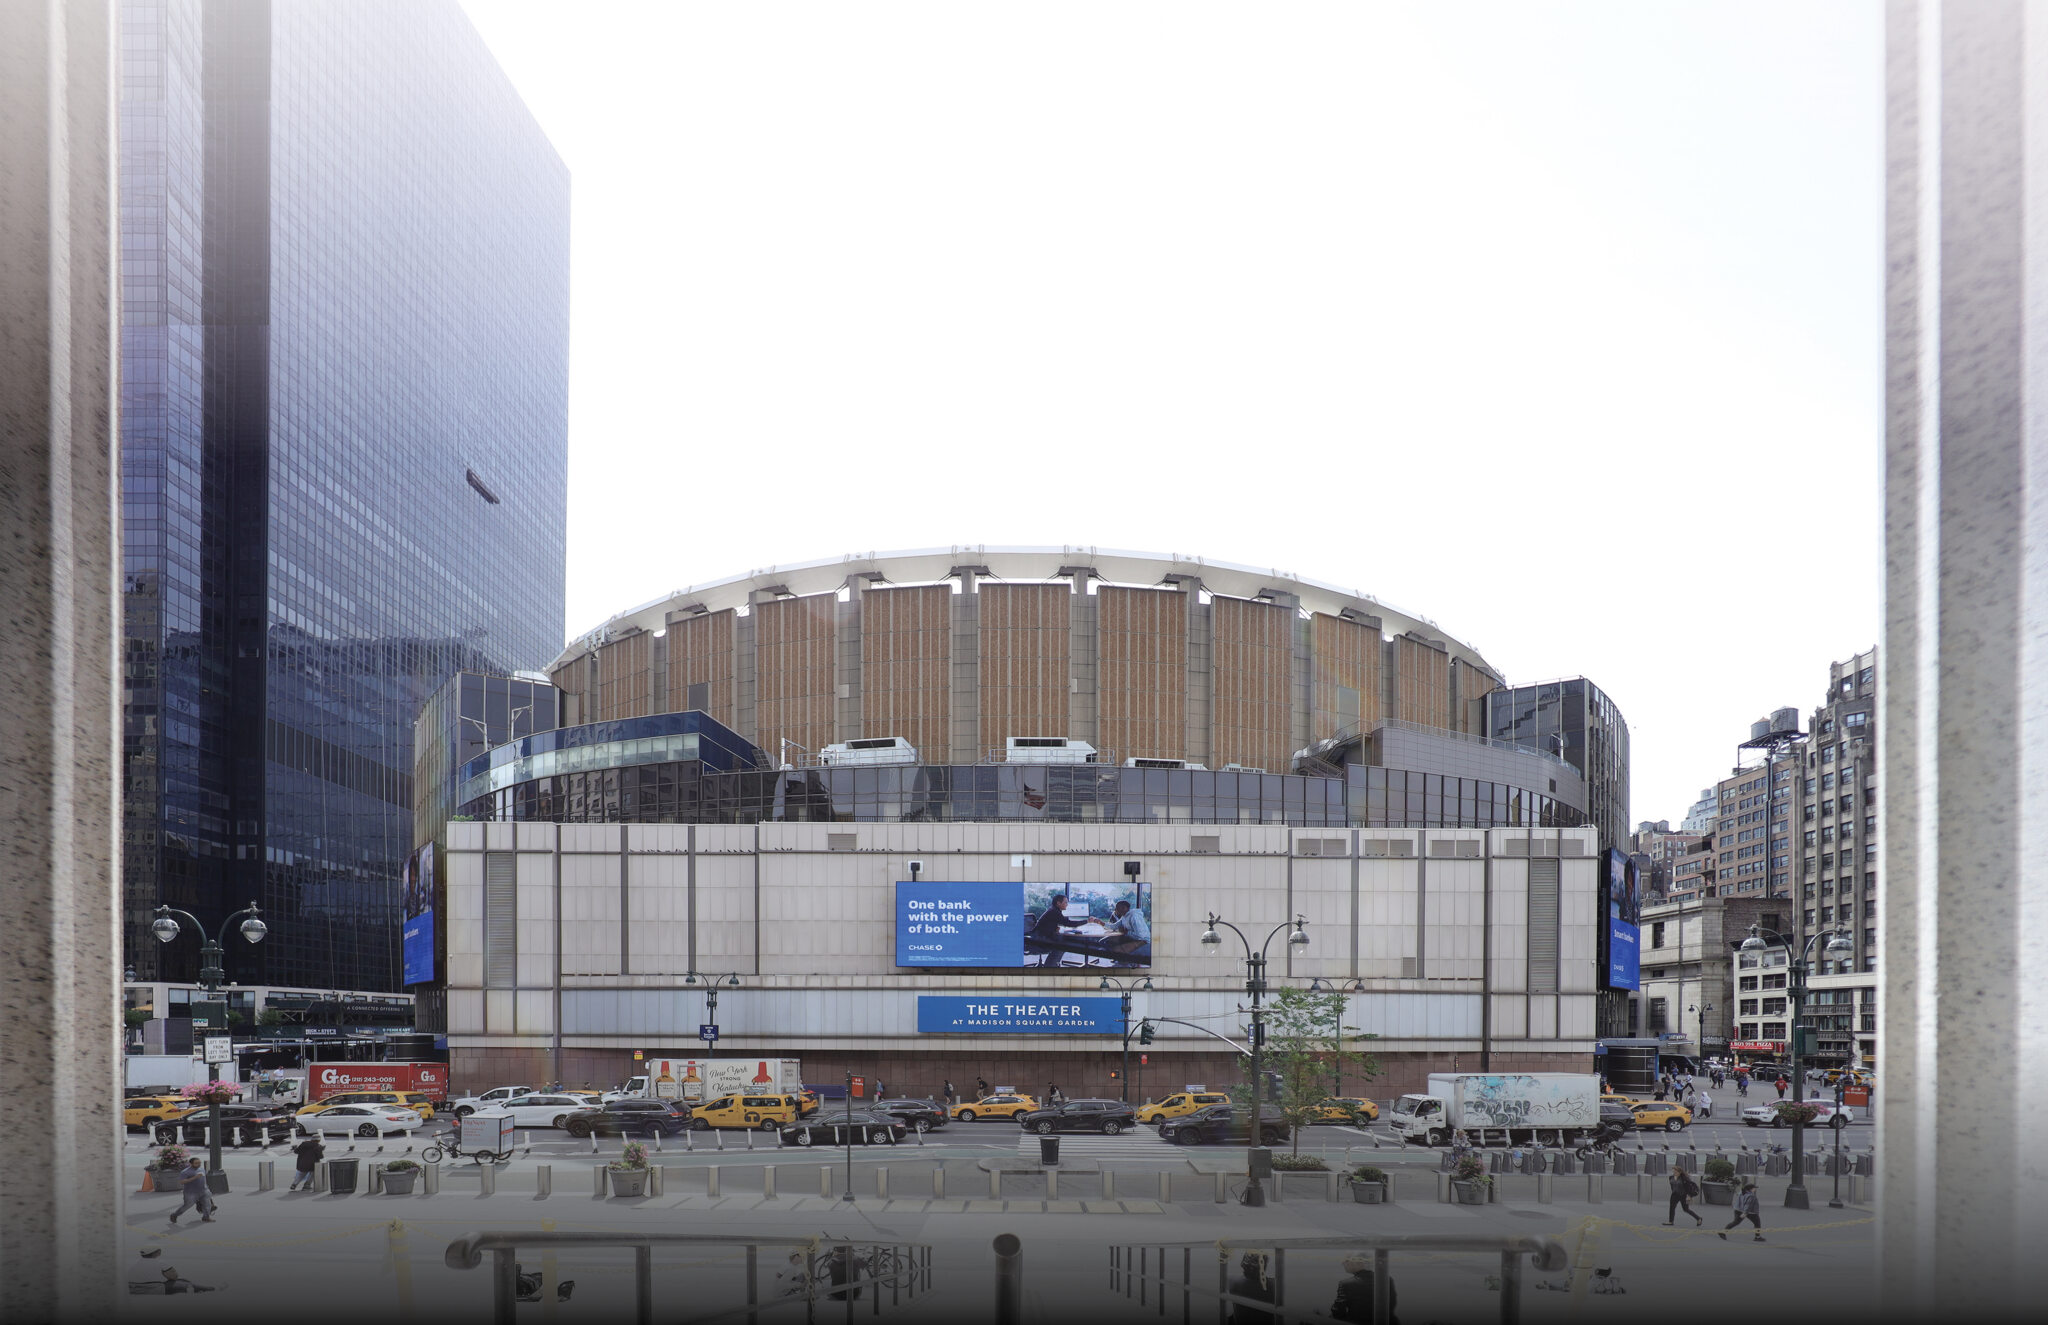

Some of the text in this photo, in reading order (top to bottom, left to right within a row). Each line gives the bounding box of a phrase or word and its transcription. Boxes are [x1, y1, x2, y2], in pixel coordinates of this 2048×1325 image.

[908, 900, 972, 910] One bank
[908, 912, 1009, 924] with the power
[908, 924, 960, 934] of both.
[966, 1004, 1081, 1016] THE THEATER
[709, 1066, 748, 1078] New York
